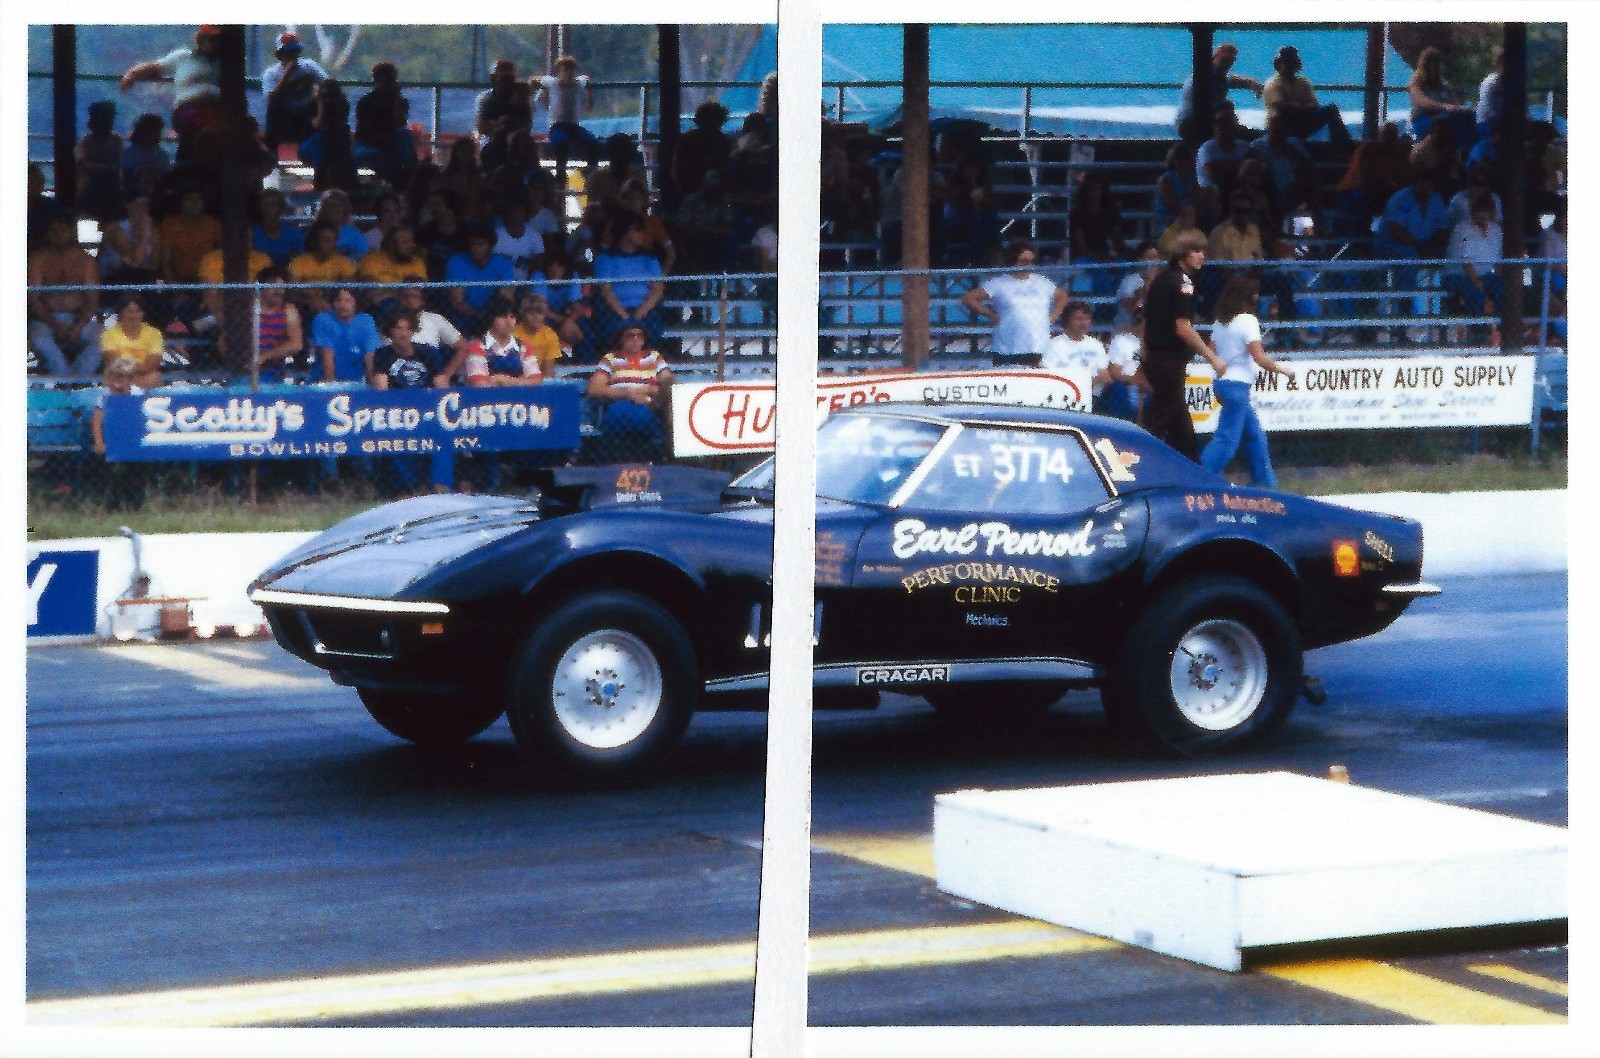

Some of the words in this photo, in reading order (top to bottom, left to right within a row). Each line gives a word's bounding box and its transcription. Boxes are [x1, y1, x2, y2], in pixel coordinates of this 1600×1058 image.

[1255, 370, 1278, 391] WN
[1306, 368, 1383, 391] COUNTRY
[1394, 366, 1443, 388] AUTO
[1454, 364, 1518, 387] SUPPLY
[922, 383, 1008, 400] CUSTOM
[1186, 386, 1213, 411] APA
[141, 397, 304, 445] Scotty's
[230, 441, 347, 456] BOWLING
[953, 453, 982, 478] ET
[990, 443, 1074, 484] 3774
[892, 518, 978, 559] Earl
[979, 518, 1096, 557] Penrod
[901, 562, 1060, 594] PERFORMANCE
[955, 586, 1021, 603] CLINIC
[861, 668, 946, 684] CRAGAR
